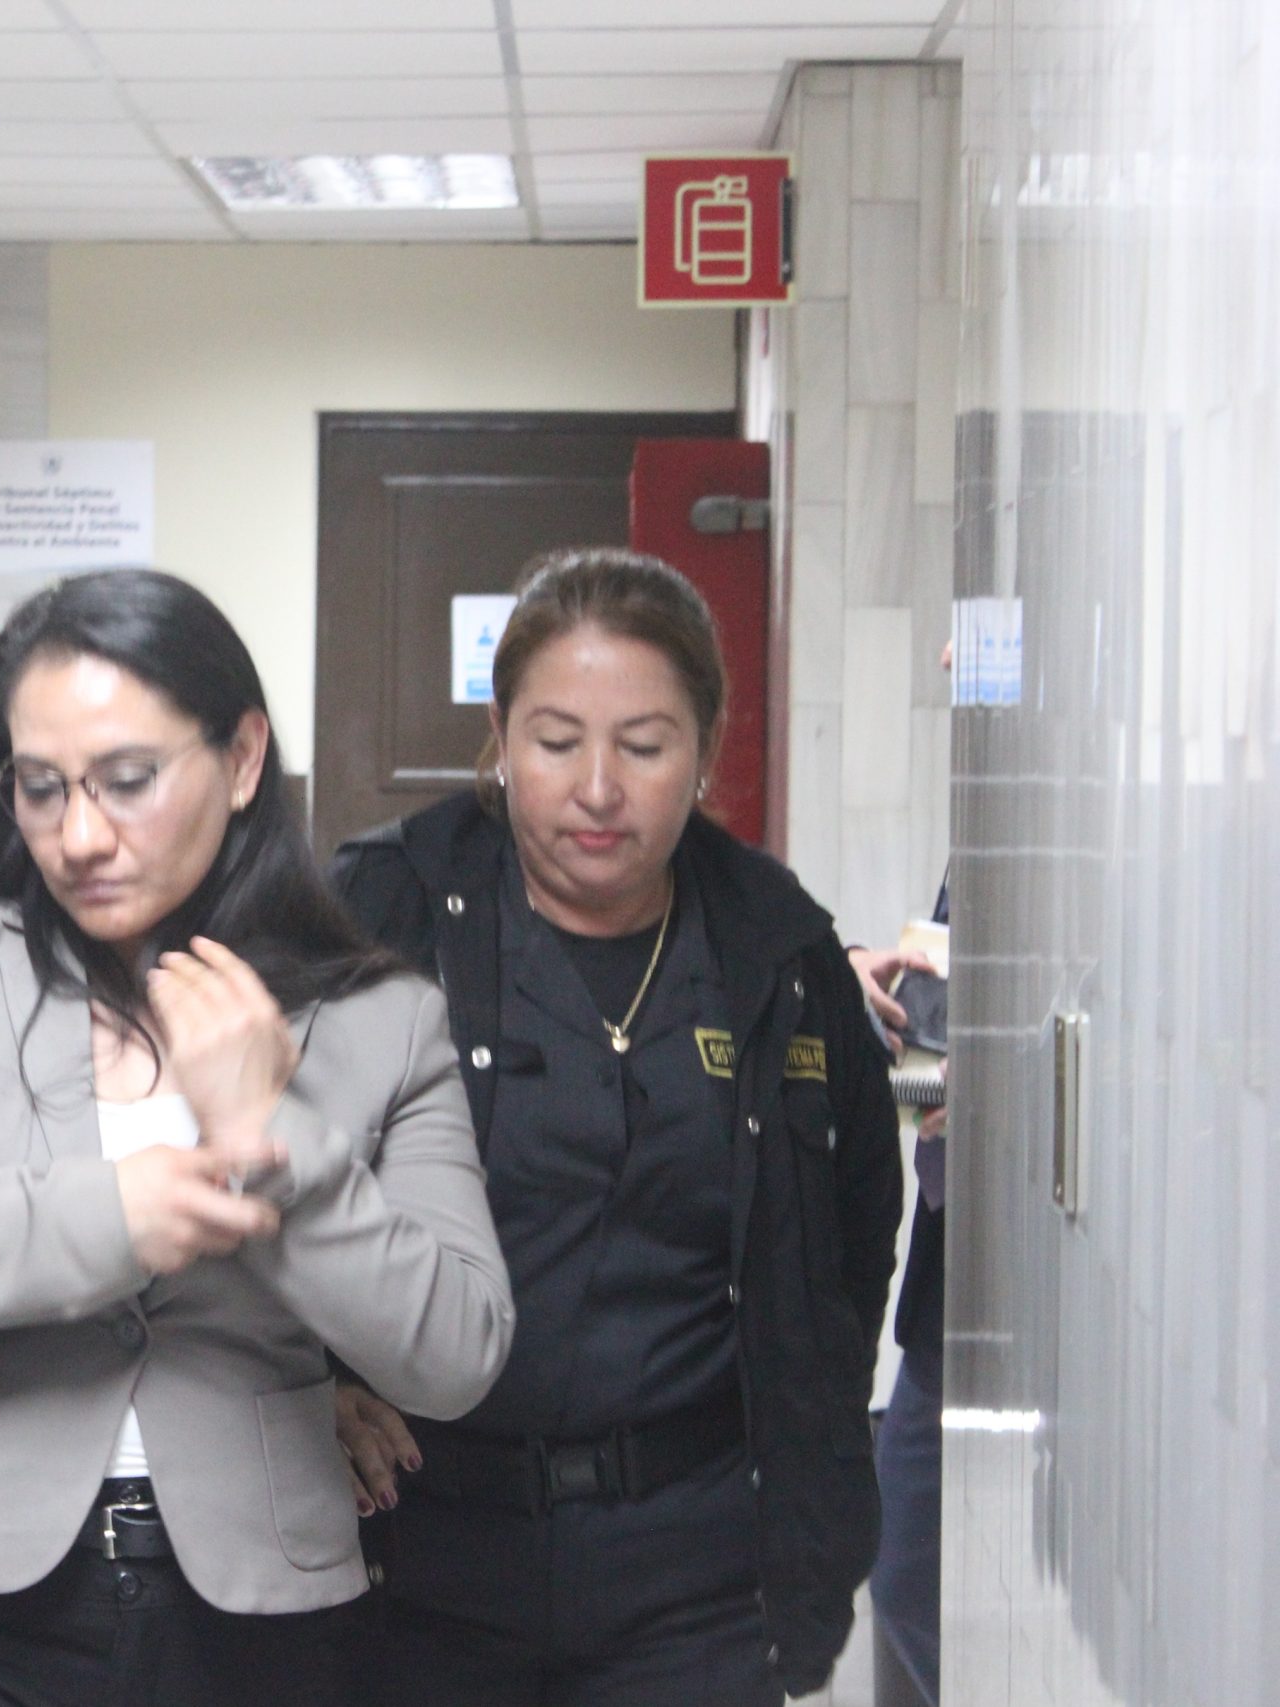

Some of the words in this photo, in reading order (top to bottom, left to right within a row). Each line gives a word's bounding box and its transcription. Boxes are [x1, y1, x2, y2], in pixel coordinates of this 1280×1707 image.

[5, 503, 74, 514] Sentencia
[80, 503, 121, 514] Penal
[89, 519, 140, 531] Delitos
[33, 536, 45, 547] el
[50, 536, 121, 547] Ambiente
